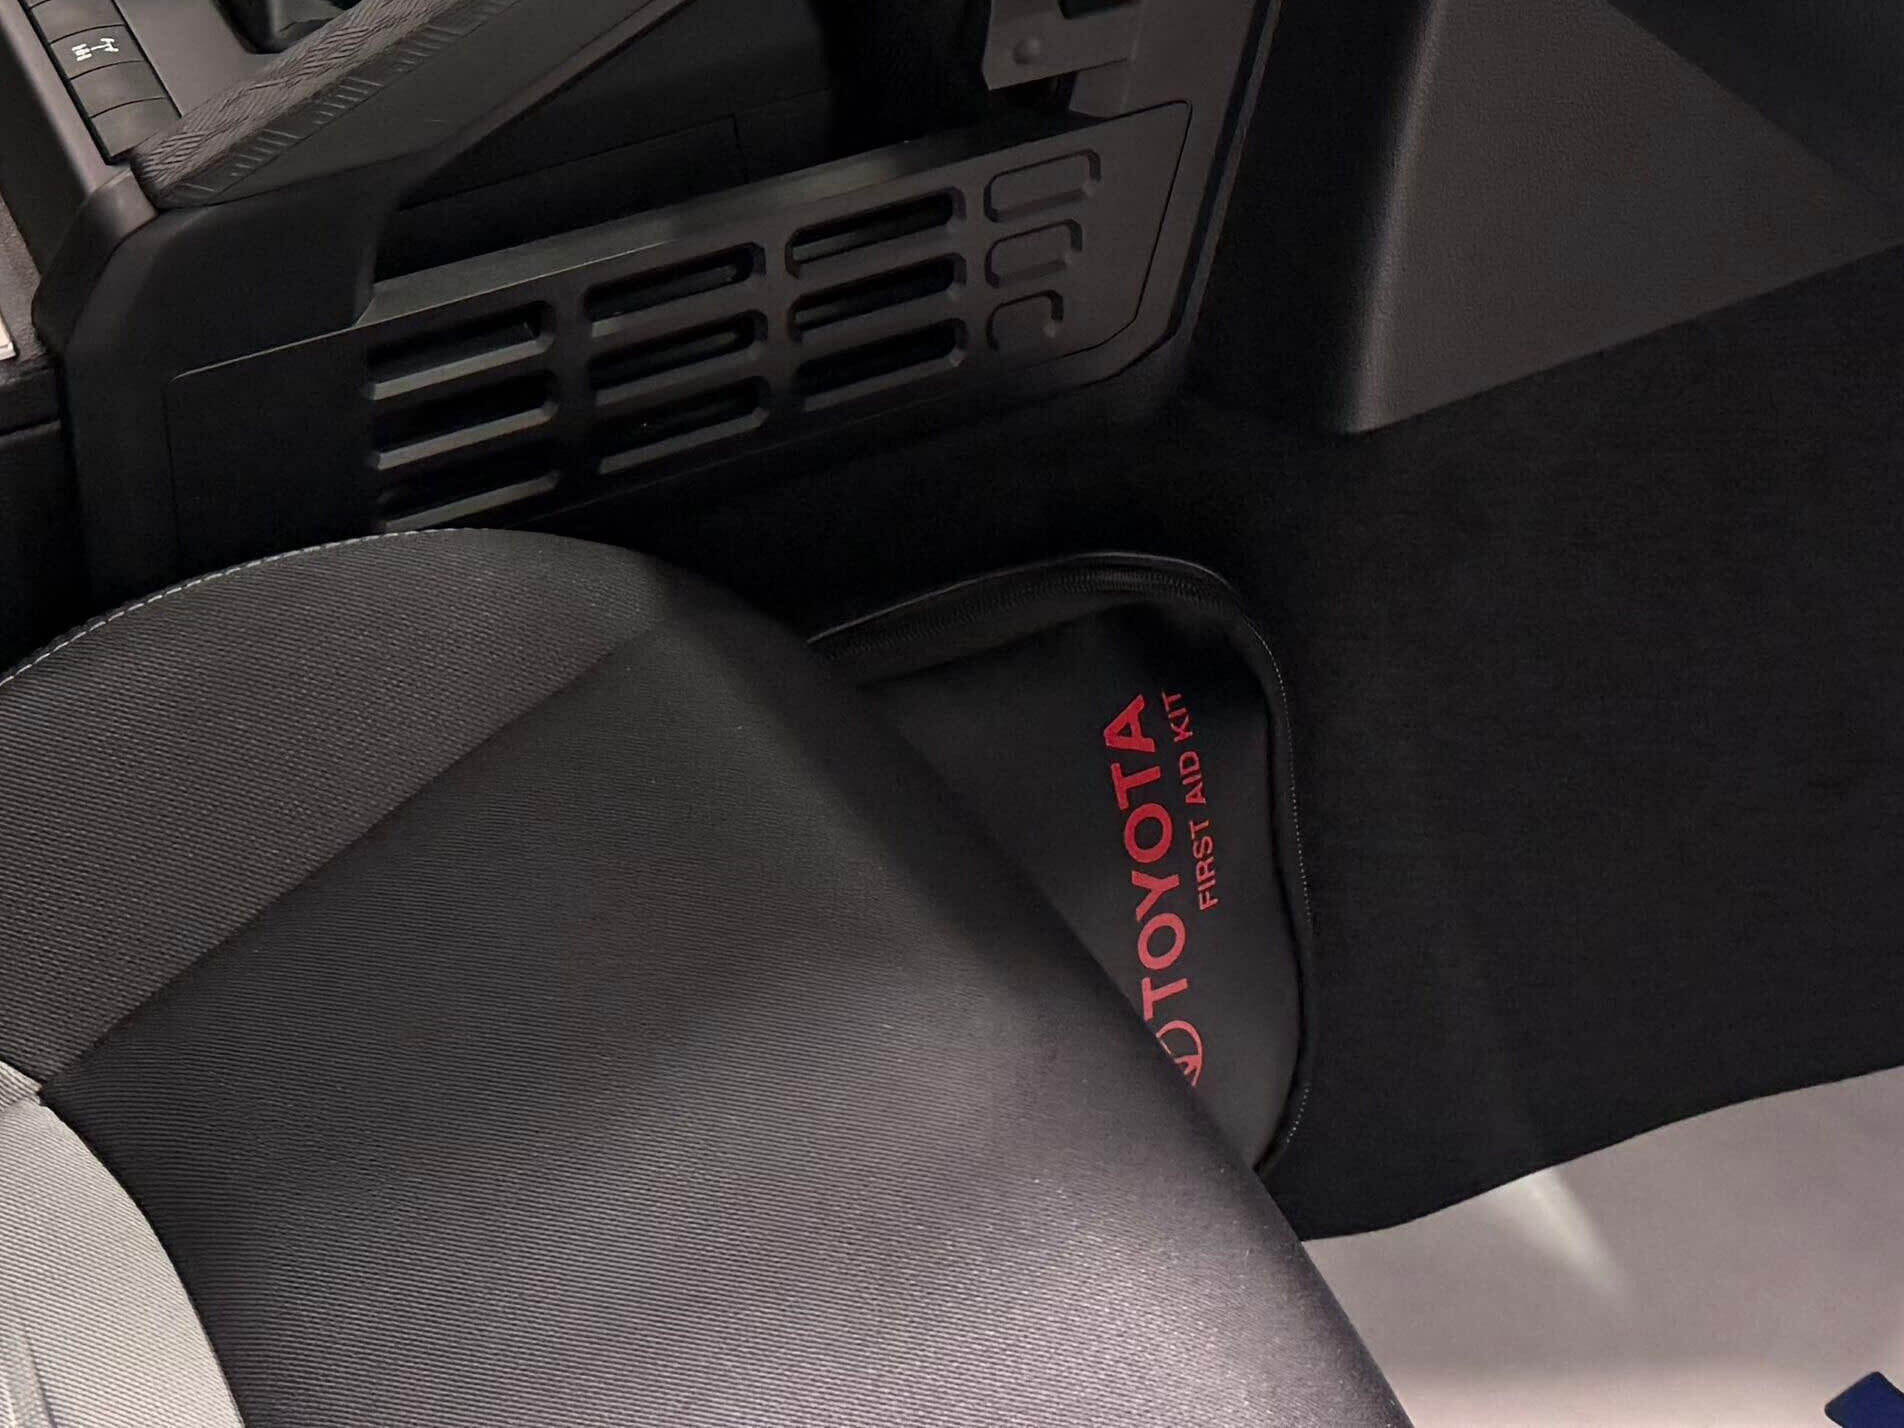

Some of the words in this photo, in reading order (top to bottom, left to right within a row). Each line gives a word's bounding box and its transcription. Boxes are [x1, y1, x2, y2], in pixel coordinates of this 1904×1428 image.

[1161, 689, 1194, 743] KIT
[1179, 751, 1207, 805] AID
[1103, 694, 1188, 1021] TOYOTA
[1189, 819, 1220, 912] FIRST
